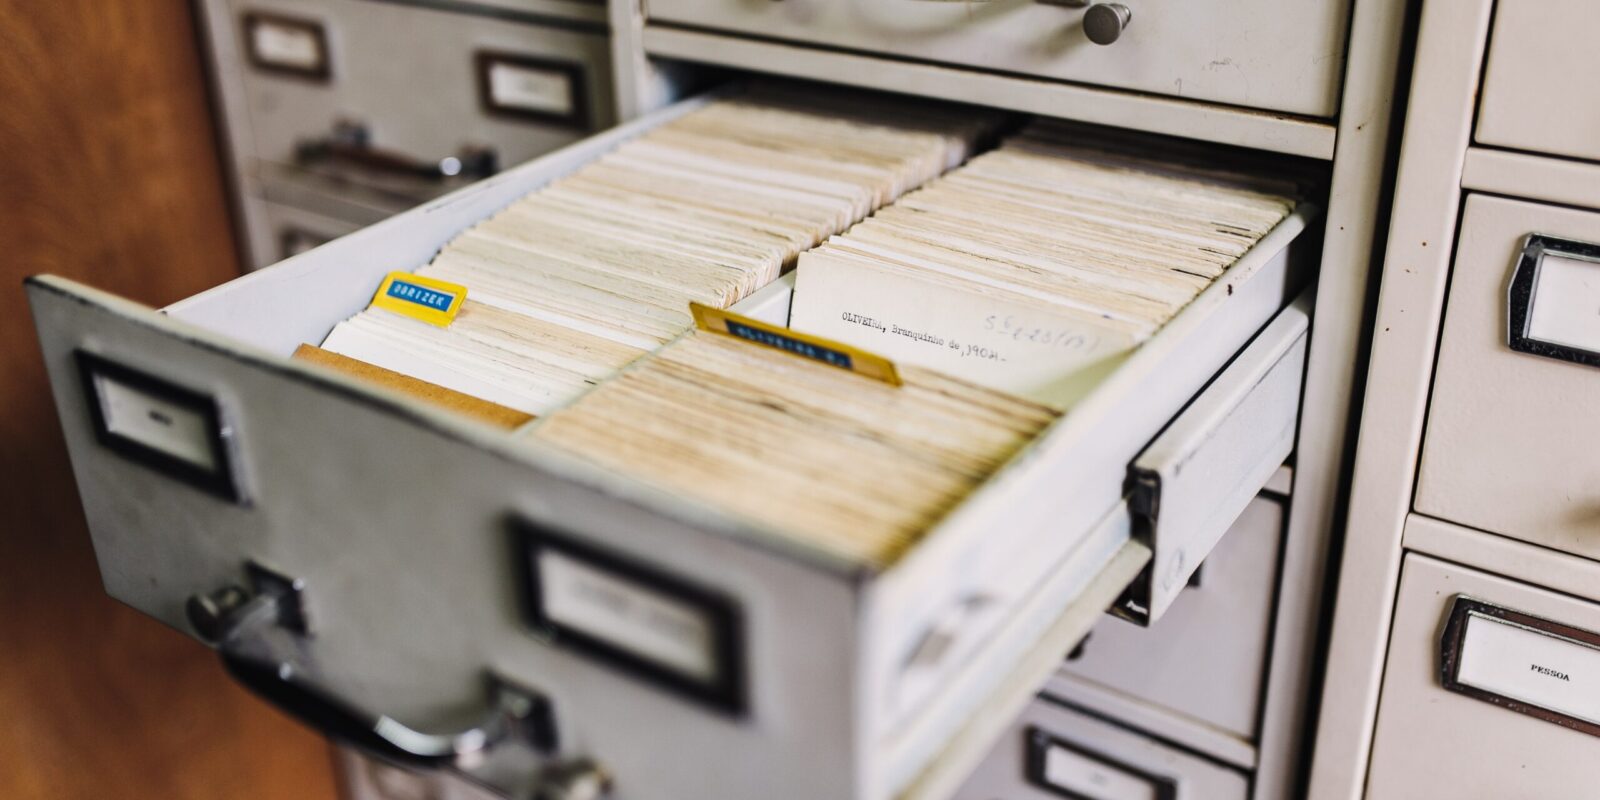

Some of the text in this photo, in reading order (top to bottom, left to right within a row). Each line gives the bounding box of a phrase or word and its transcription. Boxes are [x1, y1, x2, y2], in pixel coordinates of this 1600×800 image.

[841, 311, 887, 333] OLIVEIRA,
[891, 324, 945, 346] Branquinho
[1530, 664, 1570, 681] PESSOA
